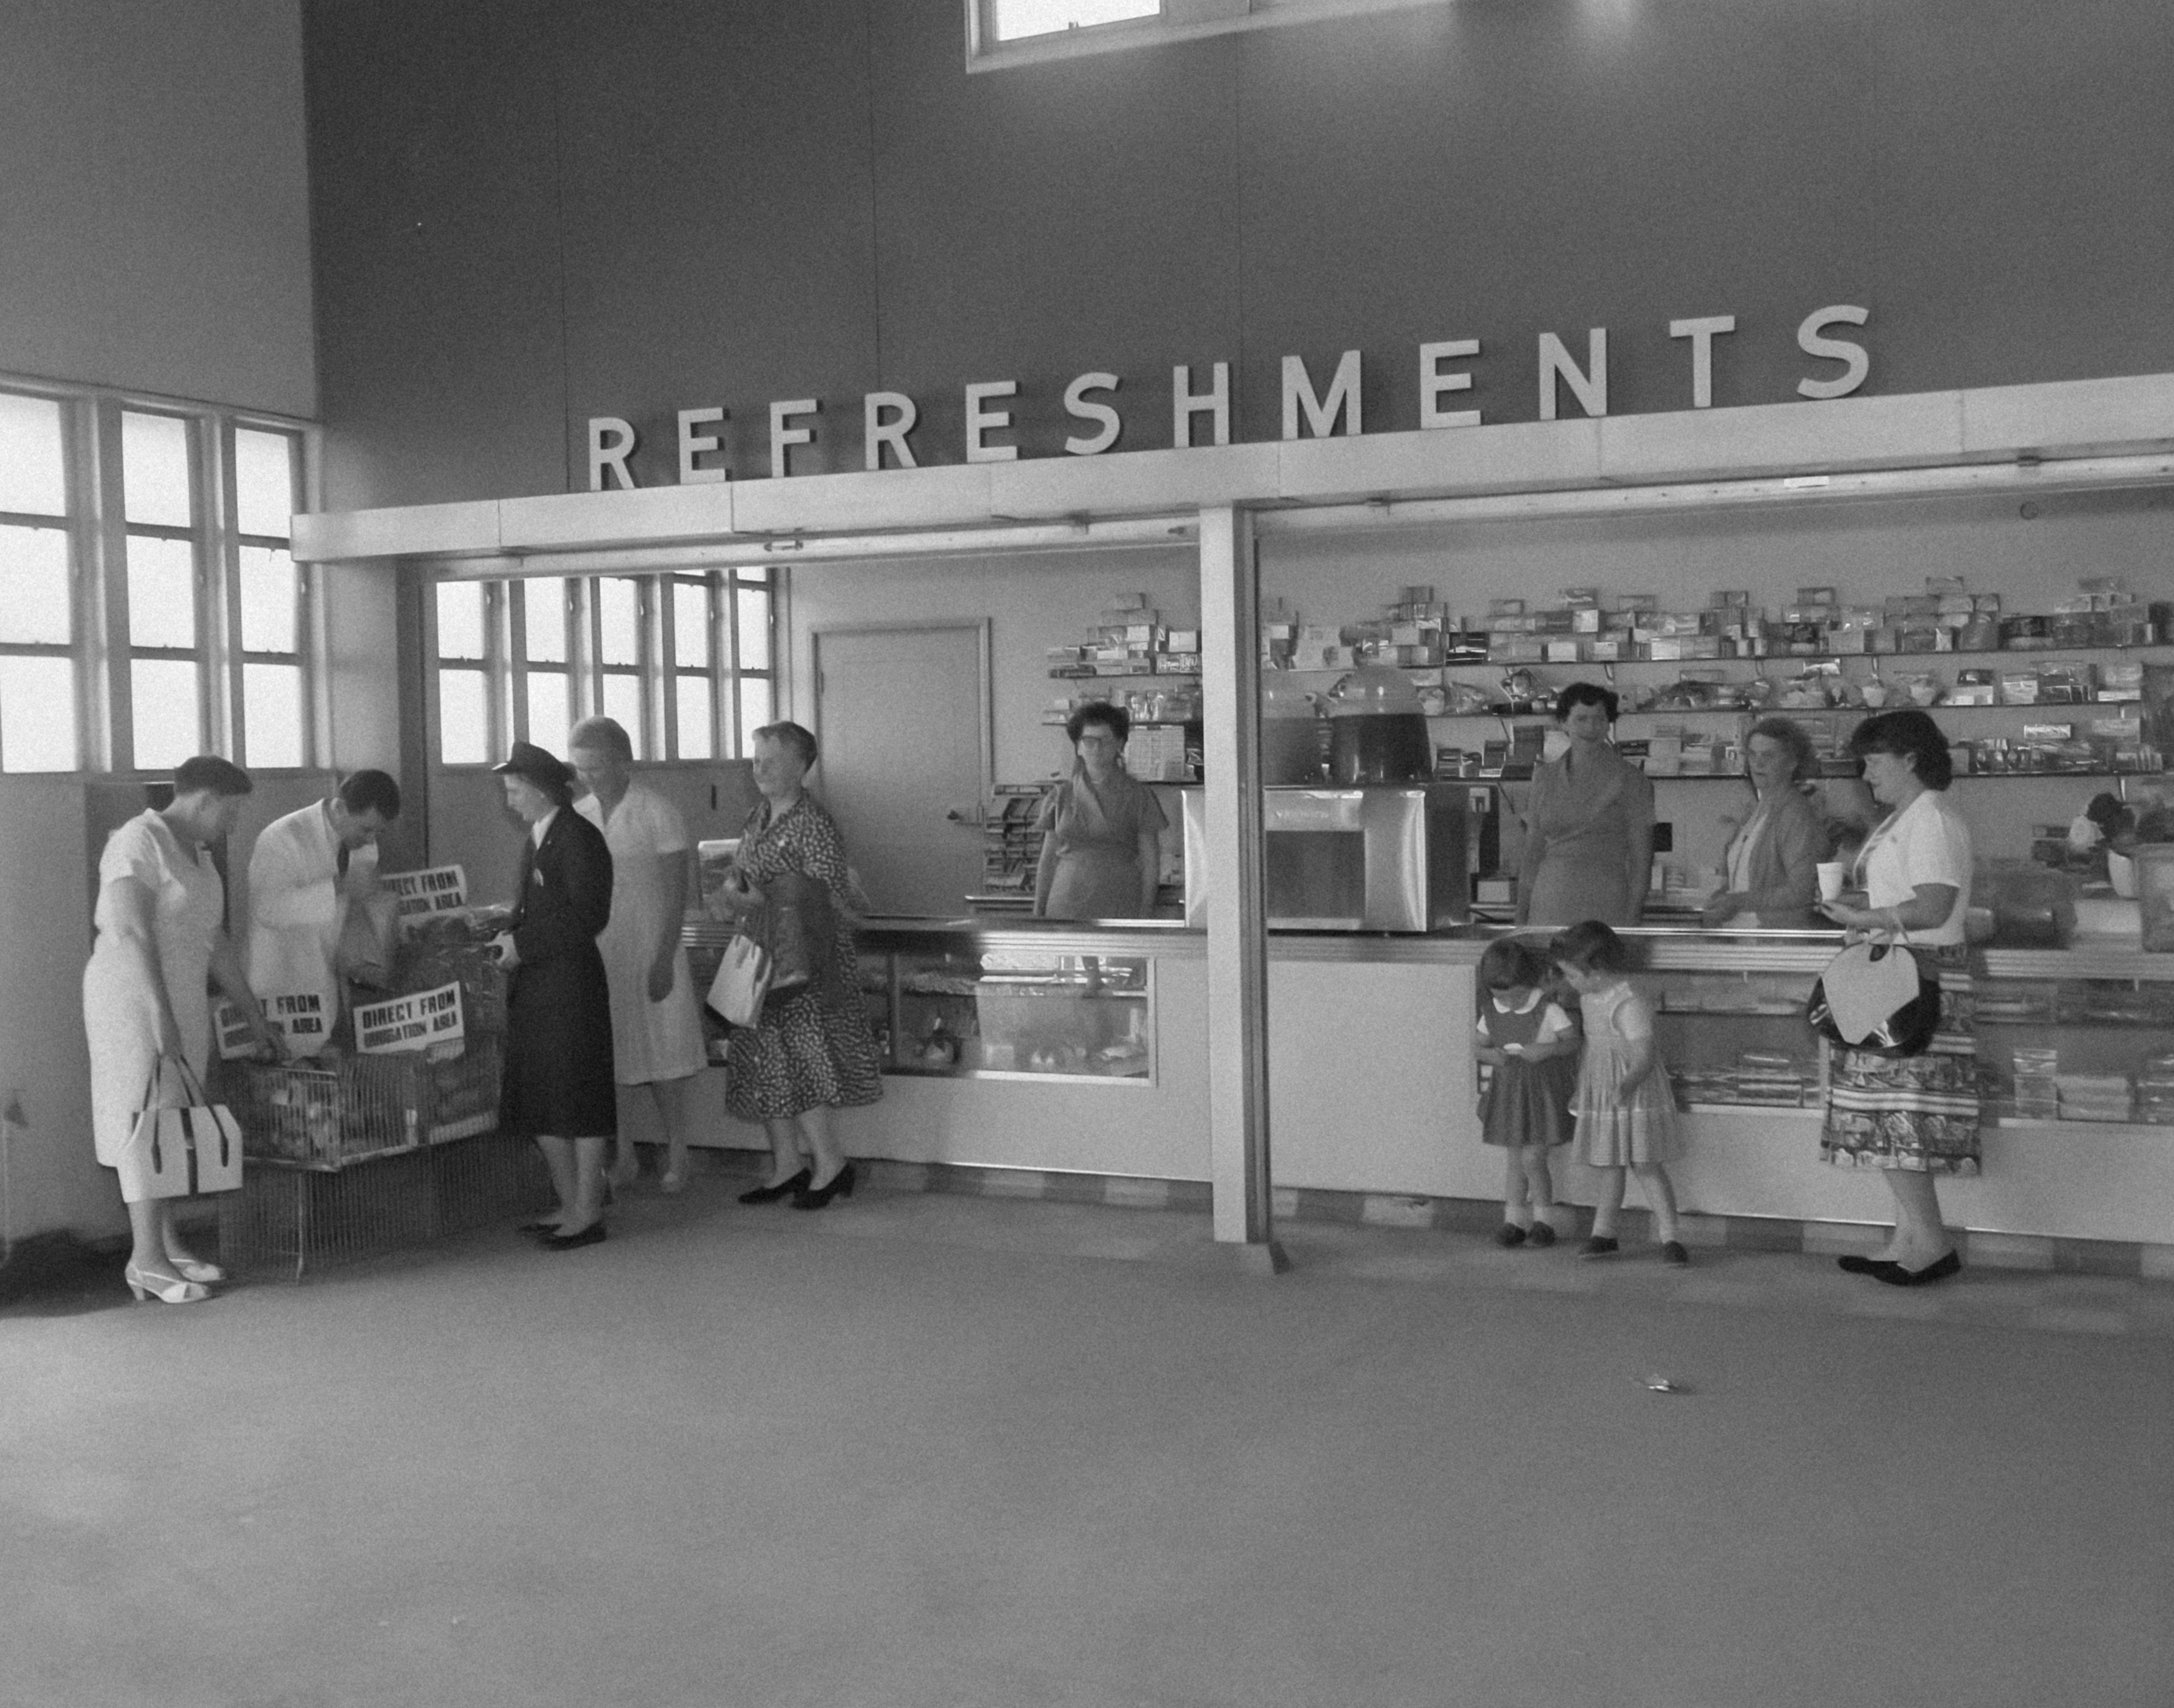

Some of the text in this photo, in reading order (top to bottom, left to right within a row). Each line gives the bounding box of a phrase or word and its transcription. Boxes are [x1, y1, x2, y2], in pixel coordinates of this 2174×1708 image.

[588, 304, 1870, 492] REFRESHMENTS
[420, 870, 460, 893] FROM
[276, 994, 321, 1014] FROM
[363, 989, 456, 1029] DIRECT FROM
